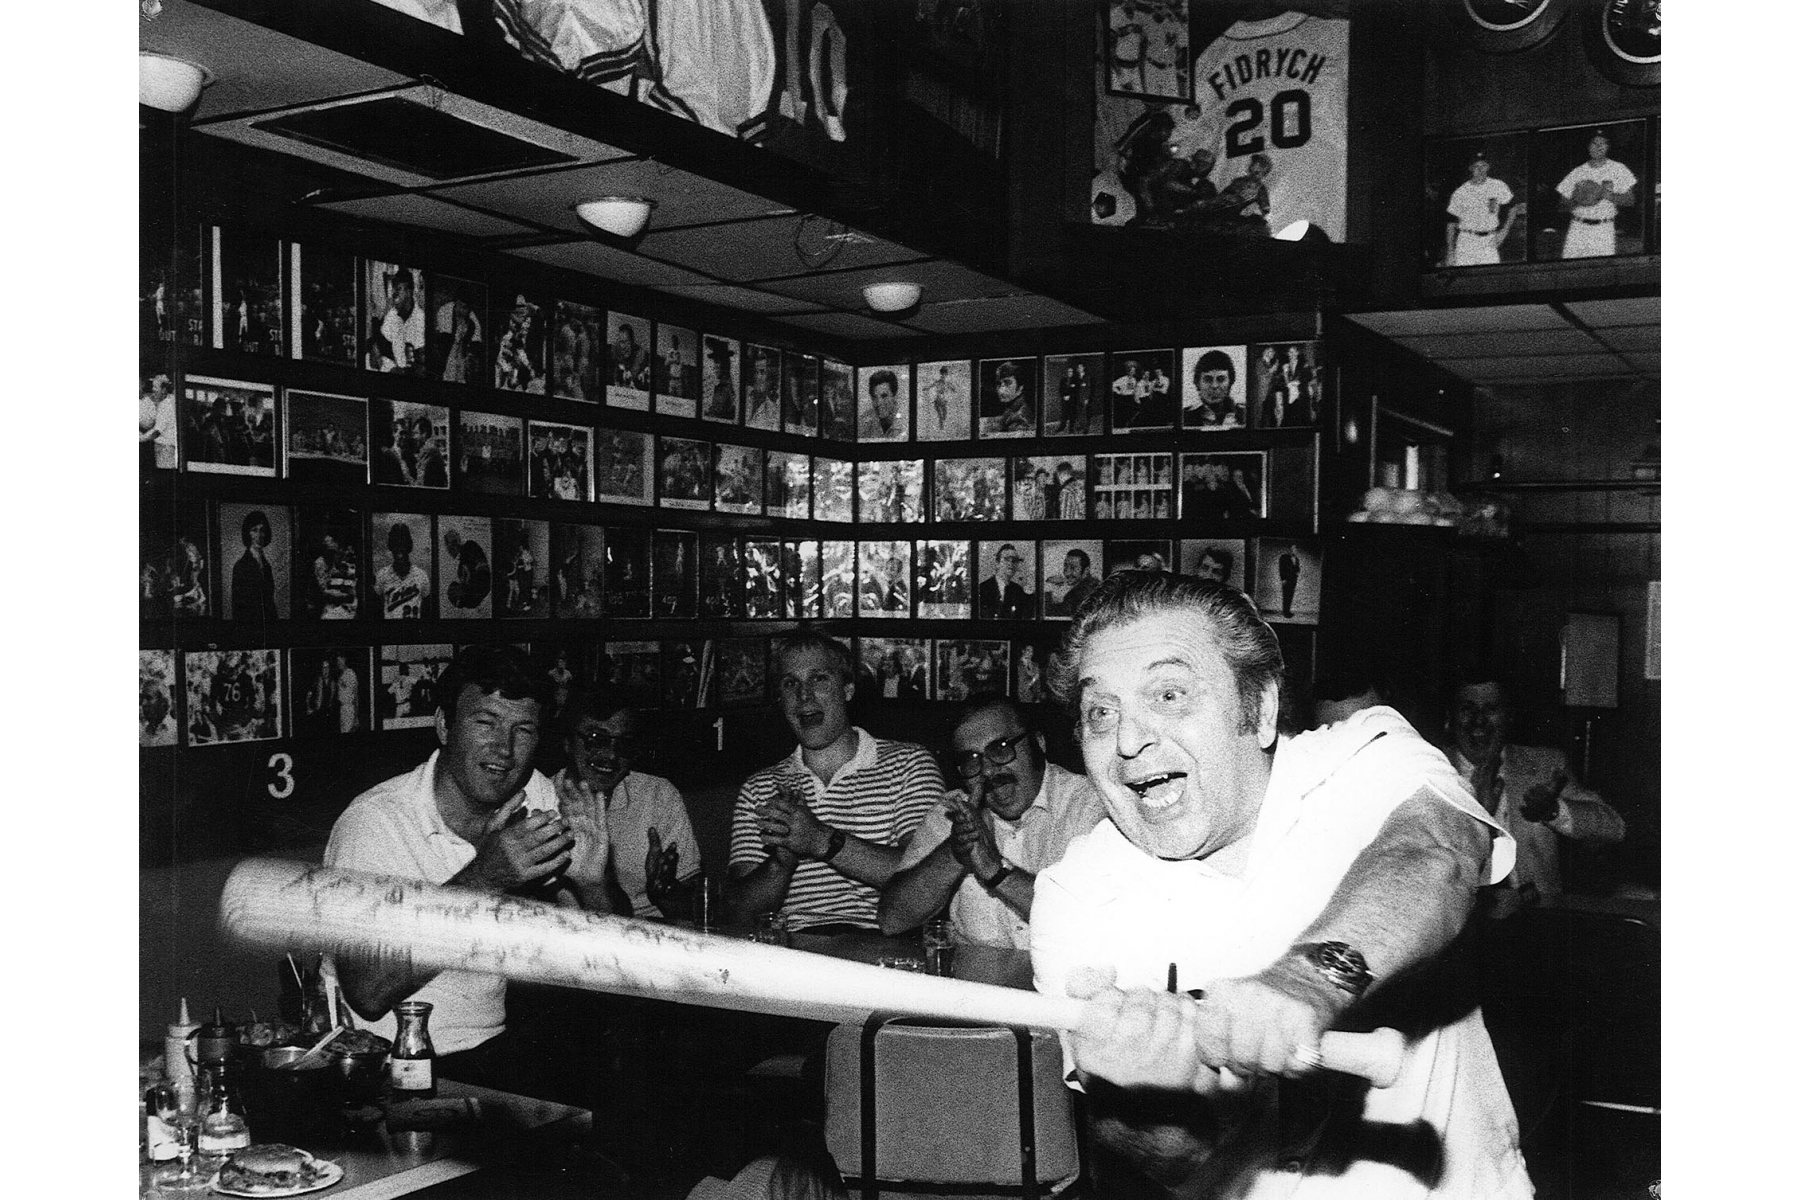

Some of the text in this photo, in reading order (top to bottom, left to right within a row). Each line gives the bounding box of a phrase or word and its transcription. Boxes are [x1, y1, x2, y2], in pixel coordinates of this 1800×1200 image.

[1208, 48, 1326, 101] FIDRYCH
[1225, 88, 1312, 159] 20
[223, 682, 241, 702] 76
[712, 717, 723, 751] 1
[267, 752, 295, 799] 3
